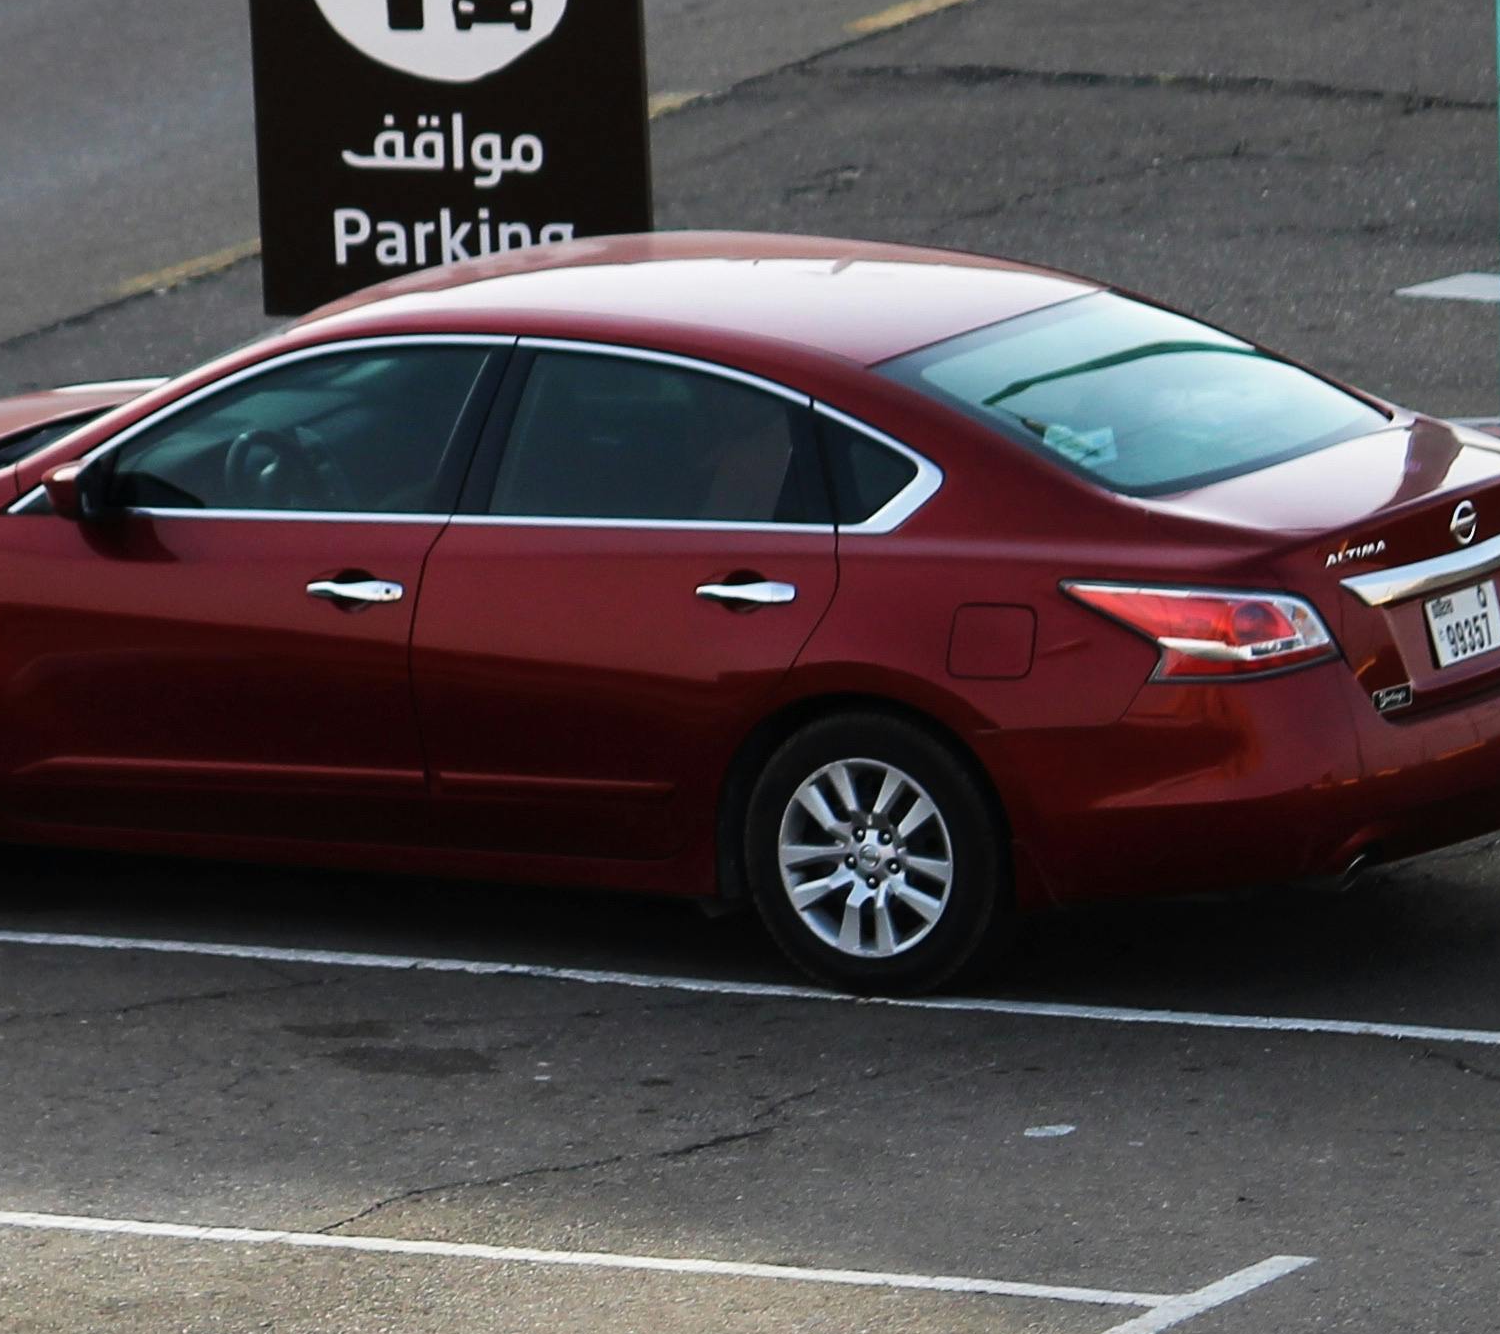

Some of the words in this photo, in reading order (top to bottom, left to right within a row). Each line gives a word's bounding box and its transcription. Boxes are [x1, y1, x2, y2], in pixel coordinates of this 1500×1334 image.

[341, 112, 544, 187] مواقف
[1324, 539, 1386, 569] ALTIMA
[1445, 612, 1492, 657] 99357
